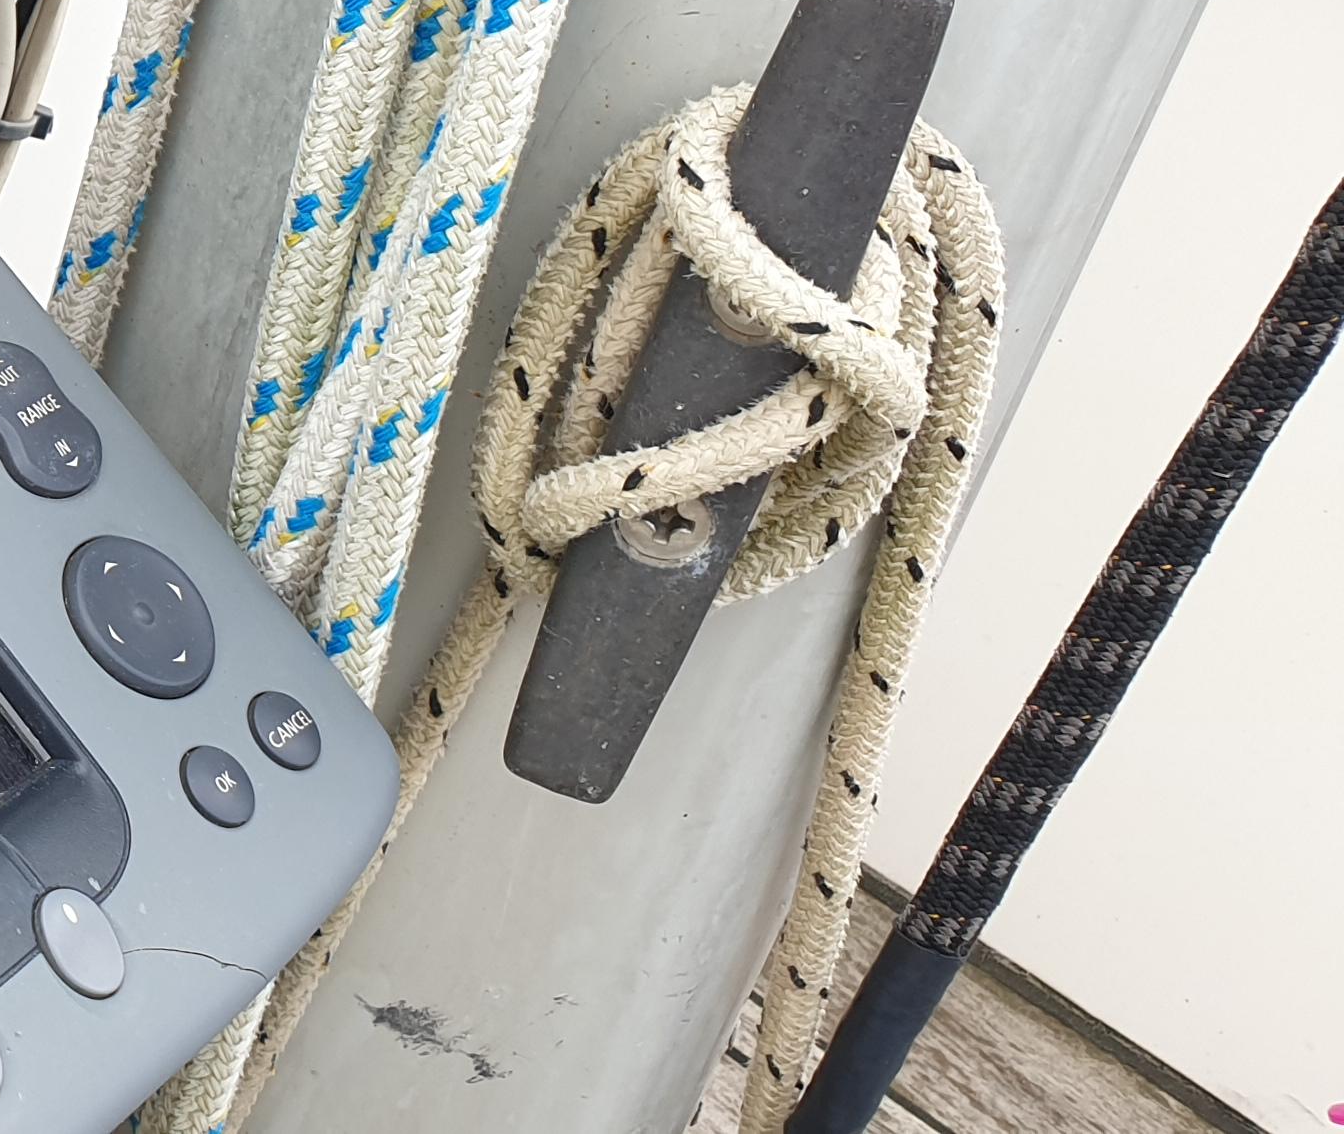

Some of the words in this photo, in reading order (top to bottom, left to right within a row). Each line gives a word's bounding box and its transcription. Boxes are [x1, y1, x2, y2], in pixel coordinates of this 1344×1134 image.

[17, 392, 62, 428] RANGE
[54, 438, 72, 458] IN
[268, 709, 314, 750] CANCEL
[215, 771, 238, 794] OK
